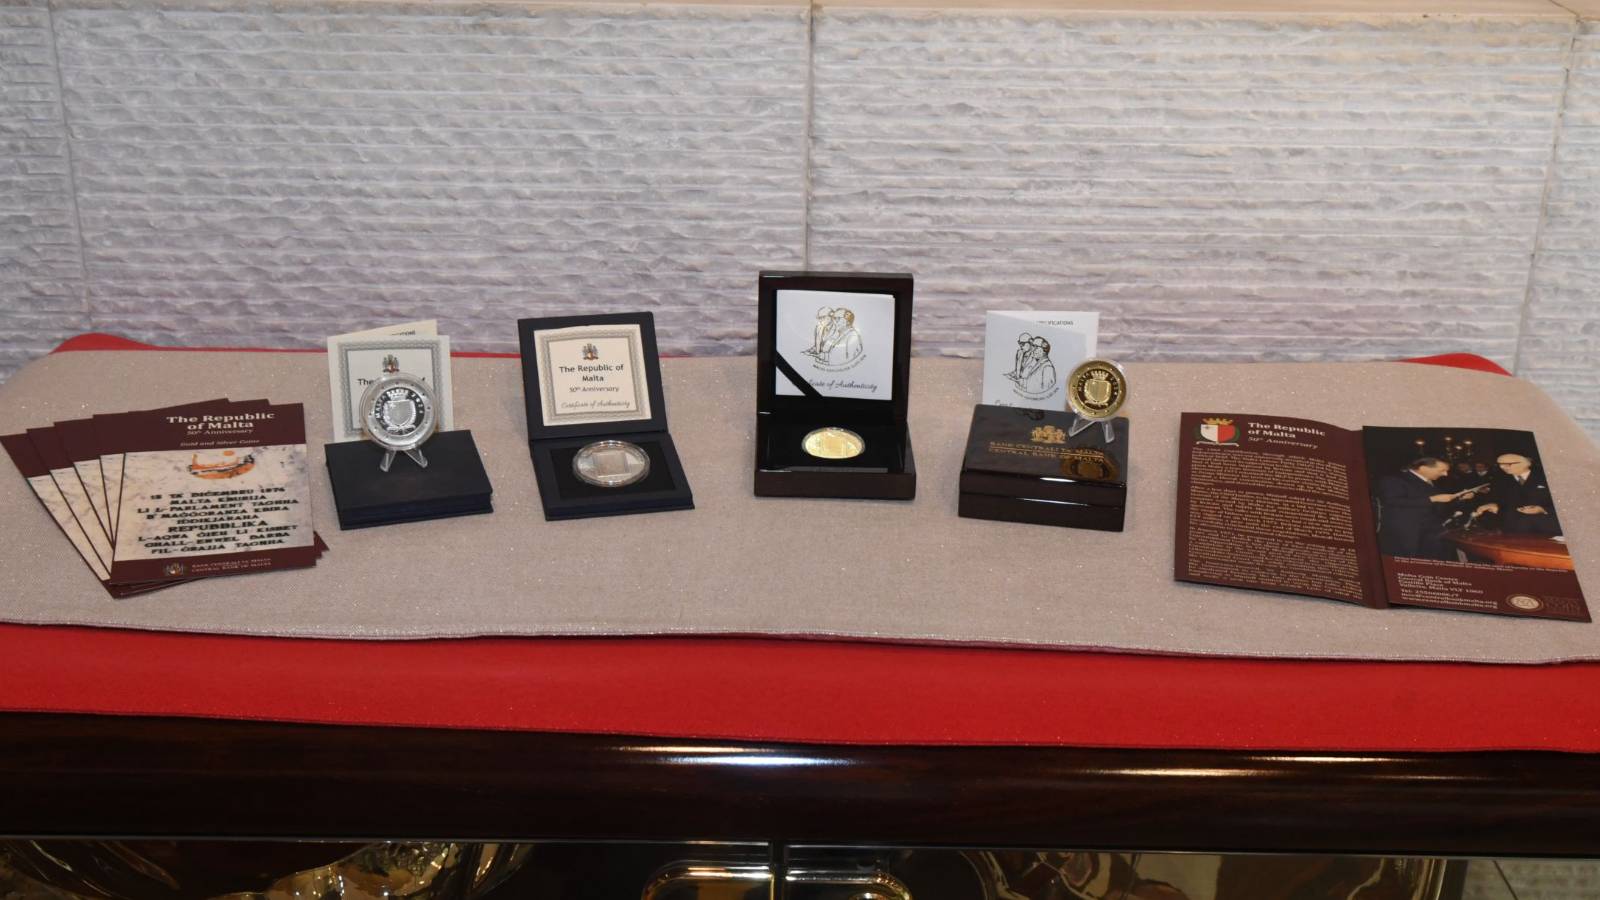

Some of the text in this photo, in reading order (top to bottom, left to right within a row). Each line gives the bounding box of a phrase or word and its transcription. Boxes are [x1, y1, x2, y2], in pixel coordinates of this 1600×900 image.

[577, 364, 613, 373] Republic
[615, 363, 624, 371] of
[835, 379, 878, 392] Authenticity
[203, 413, 276, 424] Republic
[208, 421, 254, 429] Malta
[1273, 424, 1326, 436] Republic
[1262, 430, 1296, 438] Malta
[1265, 439, 1318, 449] Anniversary
[168, 520, 268, 532] REPUBBLIKA
